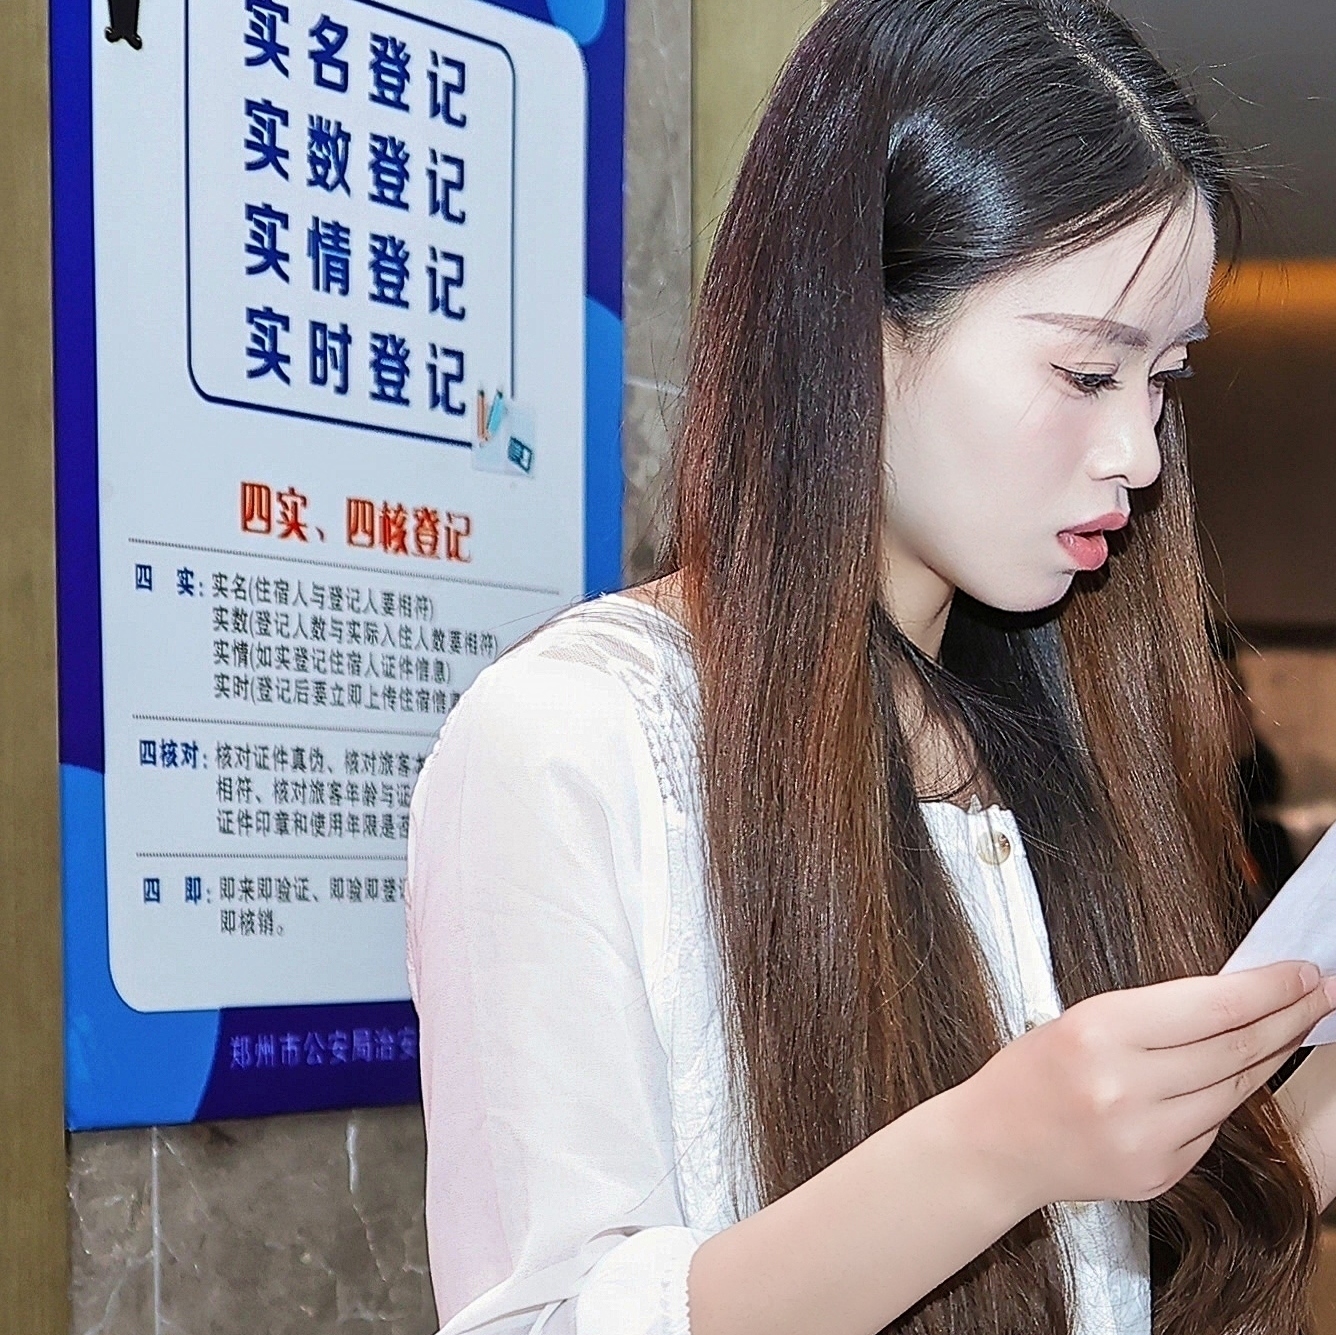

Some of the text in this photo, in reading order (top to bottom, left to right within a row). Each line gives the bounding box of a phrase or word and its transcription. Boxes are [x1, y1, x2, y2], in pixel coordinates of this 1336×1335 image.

[244, 0, 467, 128] 实名登记
[244, 97, 467, 224] 实数登记
[244, 202, 467, 321] 实情登记
[244, 306, 467, 416] 实时登记
[240, 481, 473, 564] 四实、四核登记
